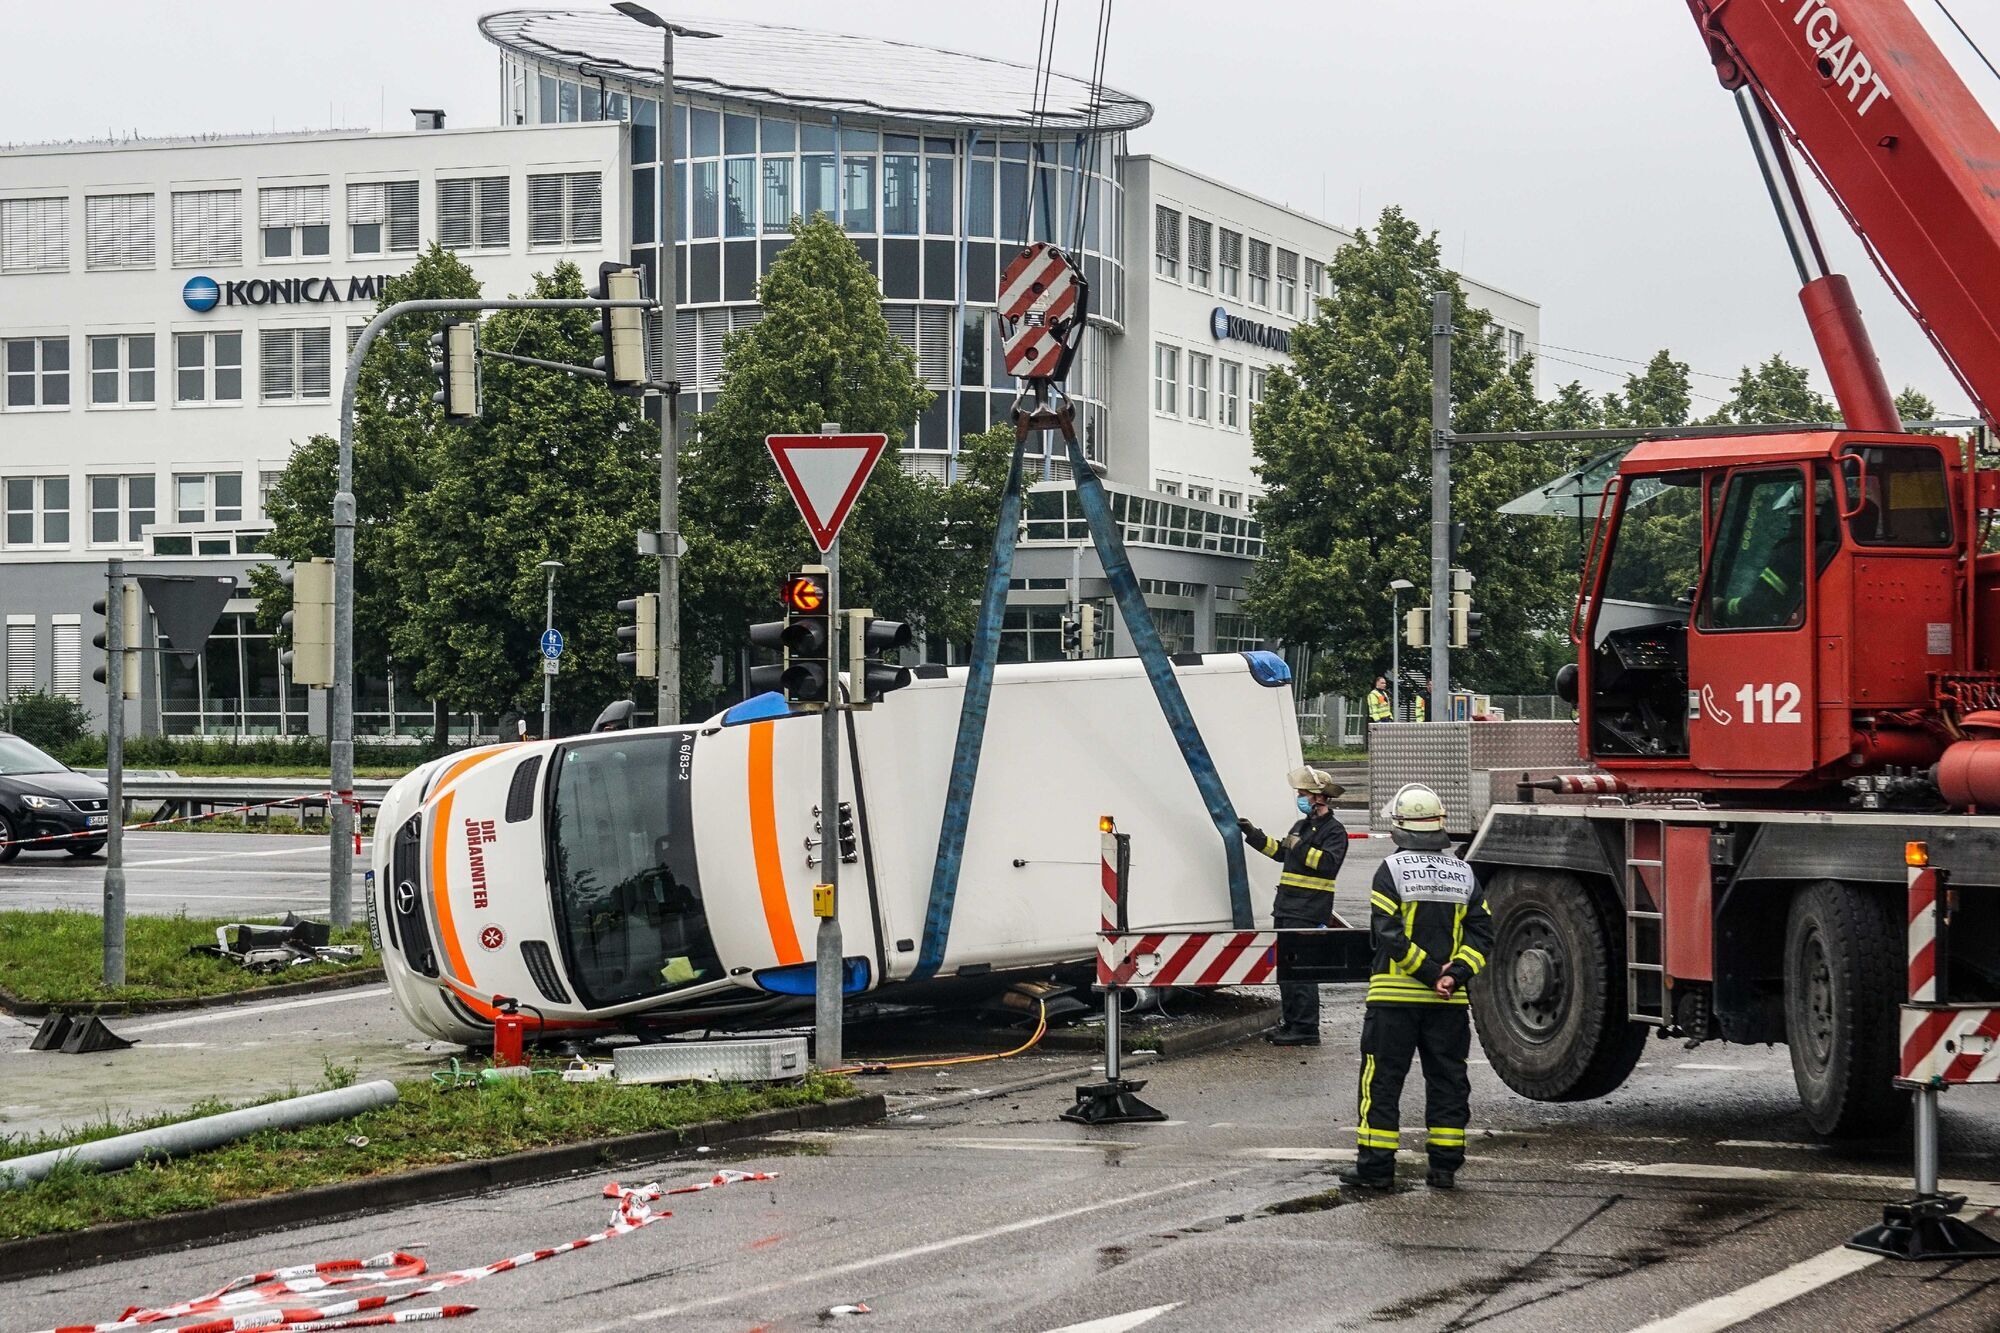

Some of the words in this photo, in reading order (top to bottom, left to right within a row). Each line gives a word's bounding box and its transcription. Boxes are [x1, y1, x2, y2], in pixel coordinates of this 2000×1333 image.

[1780, 0, 1891, 117] TGART
[226, 277, 340, 306] KONICA
[347, 275, 389, 301] MI
[1226, 315, 1268, 348] KONICA
[1268, 326, 1291, 352] MIN
[1736, 682, 1801, 723] 112
[681, 733, 692, 741] A
[679, 744, 691, 780] 6/83-2
[481, 820, 496, 843] DIE
[465, 818, 488, 909] JOHANNITER
[1395, 855, 1467, 869] FEUERWEHR
[1402, 869, 1467, 883] STUTTGART
[1405, 883, 1463, 895] Leitungsdienst
